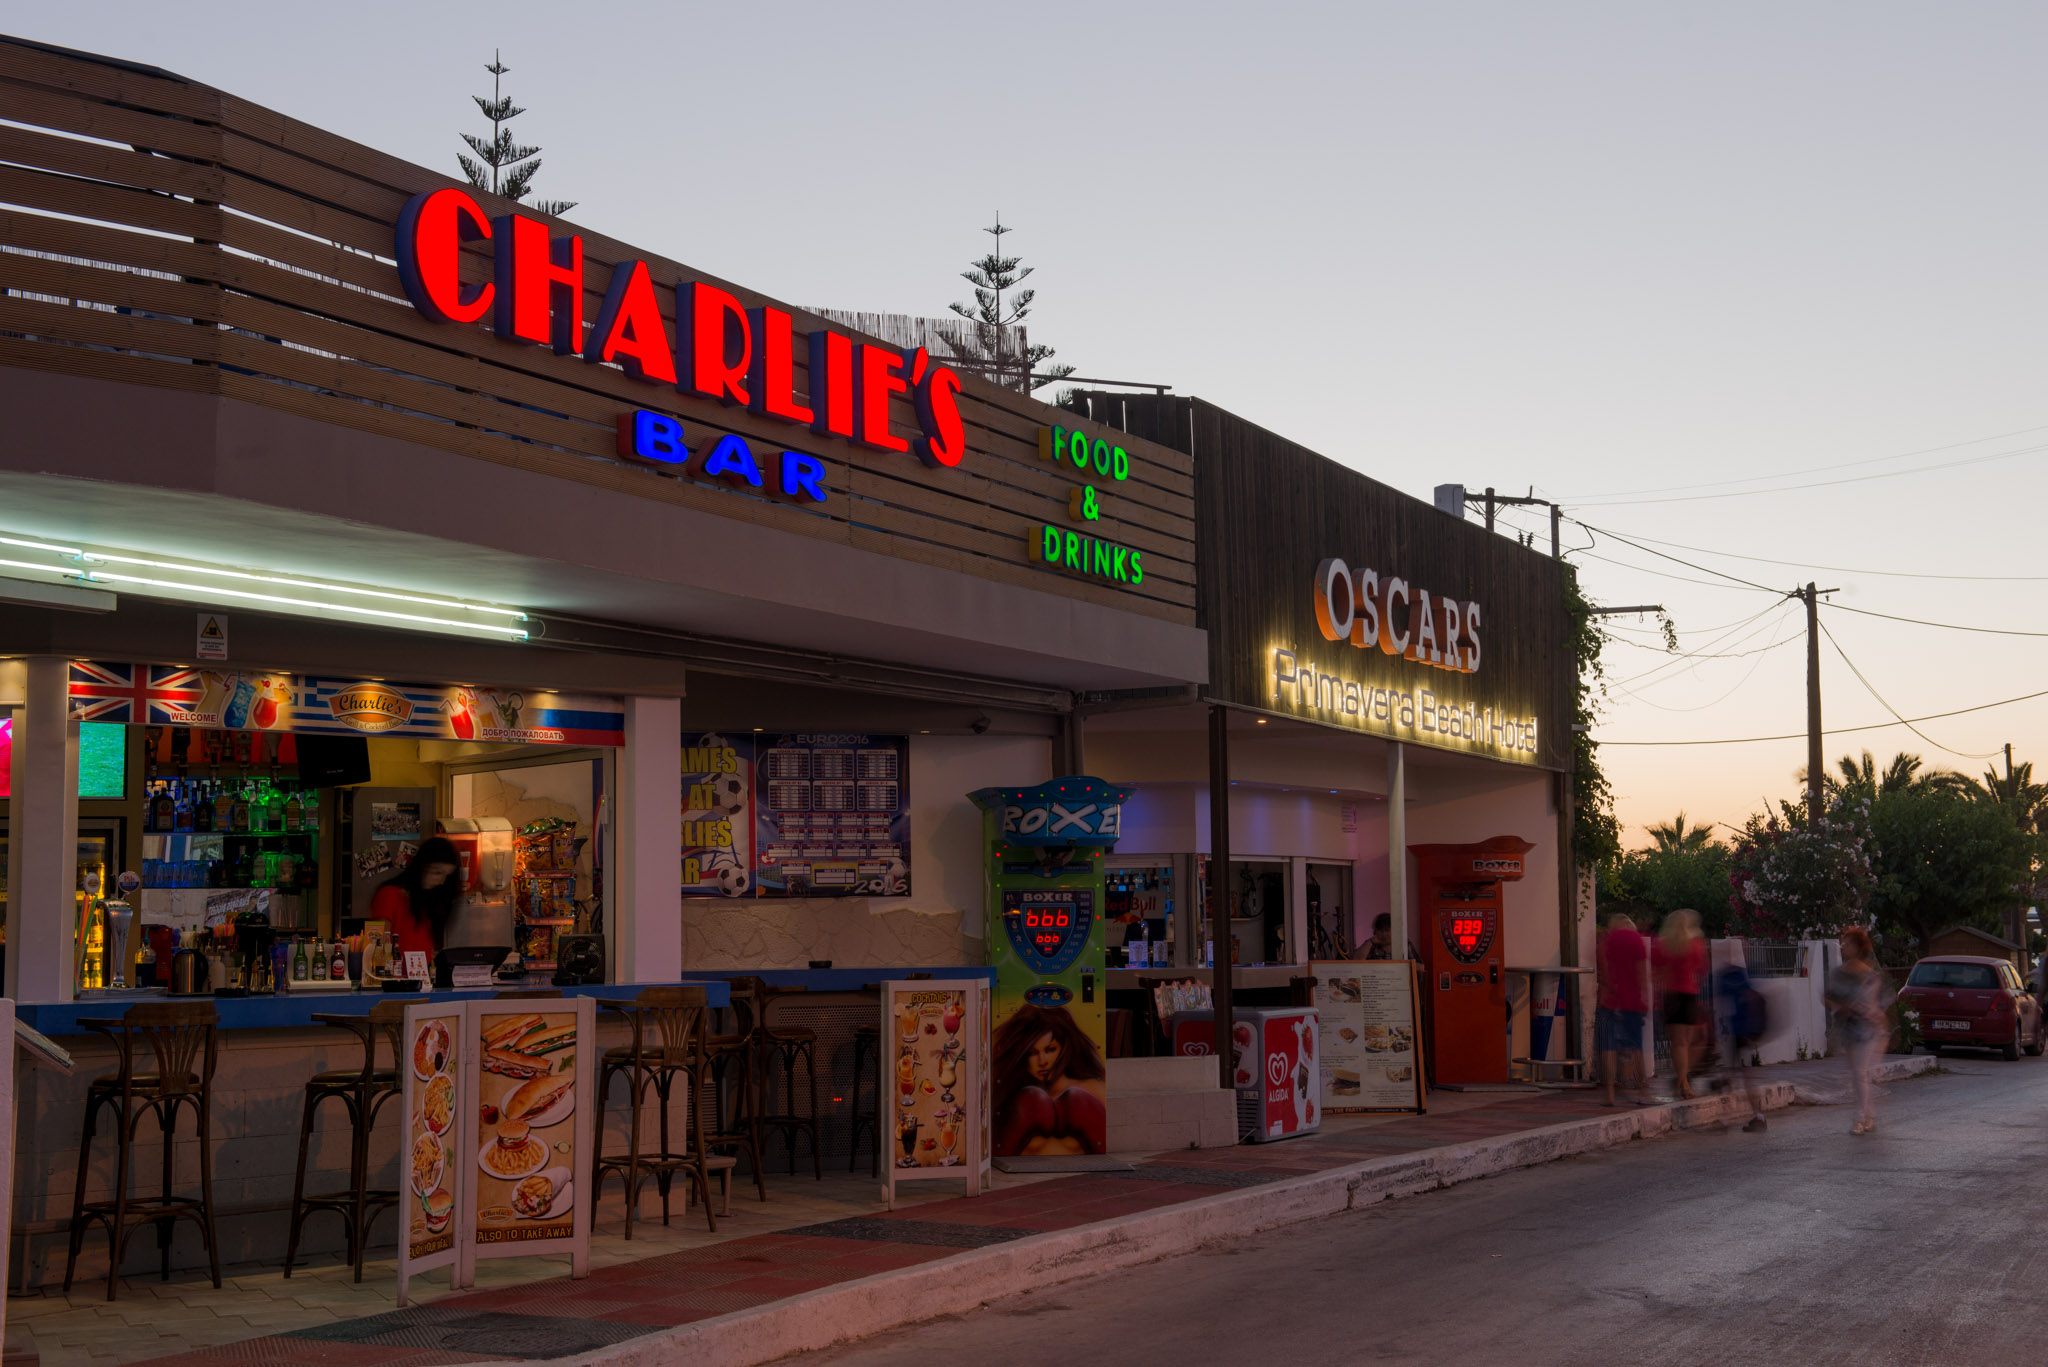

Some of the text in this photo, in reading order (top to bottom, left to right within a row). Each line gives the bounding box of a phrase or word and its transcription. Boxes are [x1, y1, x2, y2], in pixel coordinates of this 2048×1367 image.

[412, 187, 965, 468] CHARLIE'S
[632, 409, 827, 502] BAR
[1051, 424, 1129, 481] FOOD
[1080, 484, 1099, 521] &
[1041, 525, 1143, 584] DRINKS
[1322, 558, 1481, 674] OSCARS
[339, 694, 402, 715] Charlie's
[1273, 648, 1538, 754] Primavera Beach Hotel
[171, 712, 217, 723] WELCOME
[482, 728, 565, 740] ДОБРО ПОЖАЛОВАТЬ
[688, 784, 717, 810] AT
[681, 820, 732, 847] LIES
[1474, 861, 1521, 871] BOXER
[1023, 892, 1073, 902] BOXER
[912, 992, 947, 1003] COCKTAILS
[1268, 1089, 1289, 1103] ALGIDA
[477, 1226, 572, 1243] ALSO TO TAKE AWAY
